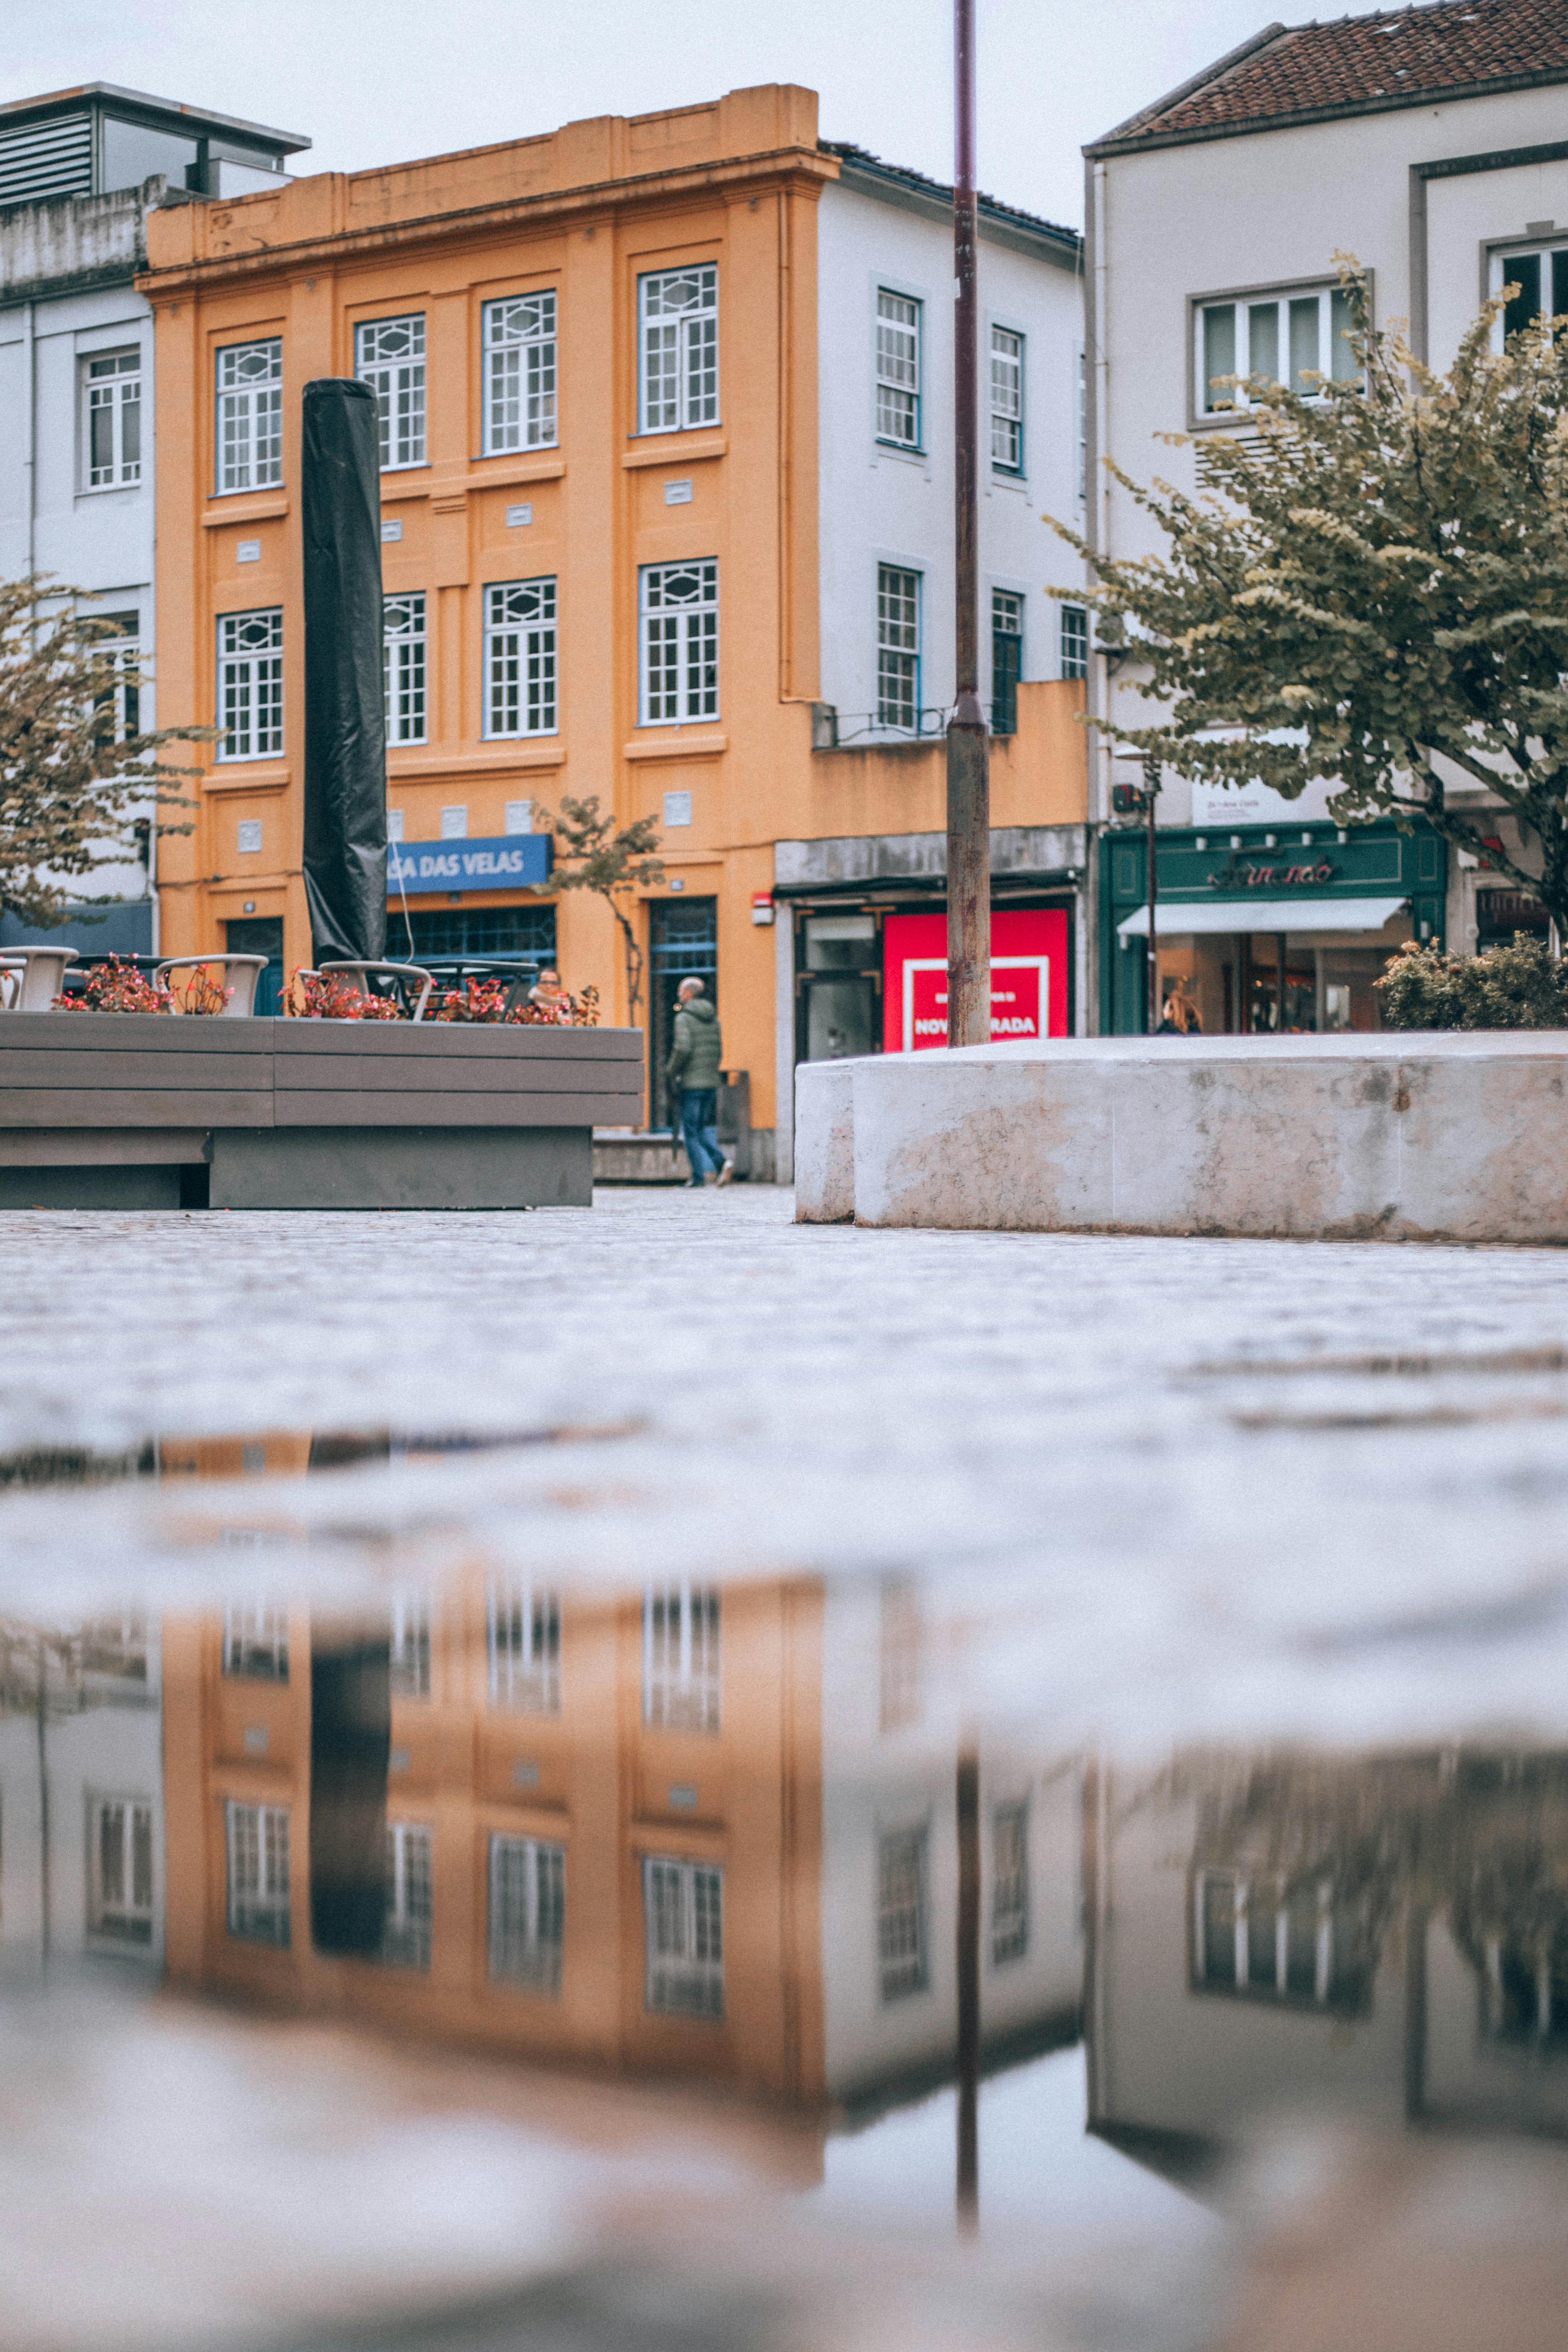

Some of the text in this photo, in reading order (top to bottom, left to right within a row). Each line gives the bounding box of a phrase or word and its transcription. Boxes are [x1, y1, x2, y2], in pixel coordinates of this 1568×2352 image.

[387, 850, 524, 879] SA DAS VELAS
[990, 1017, 1036, 1033] RADA
